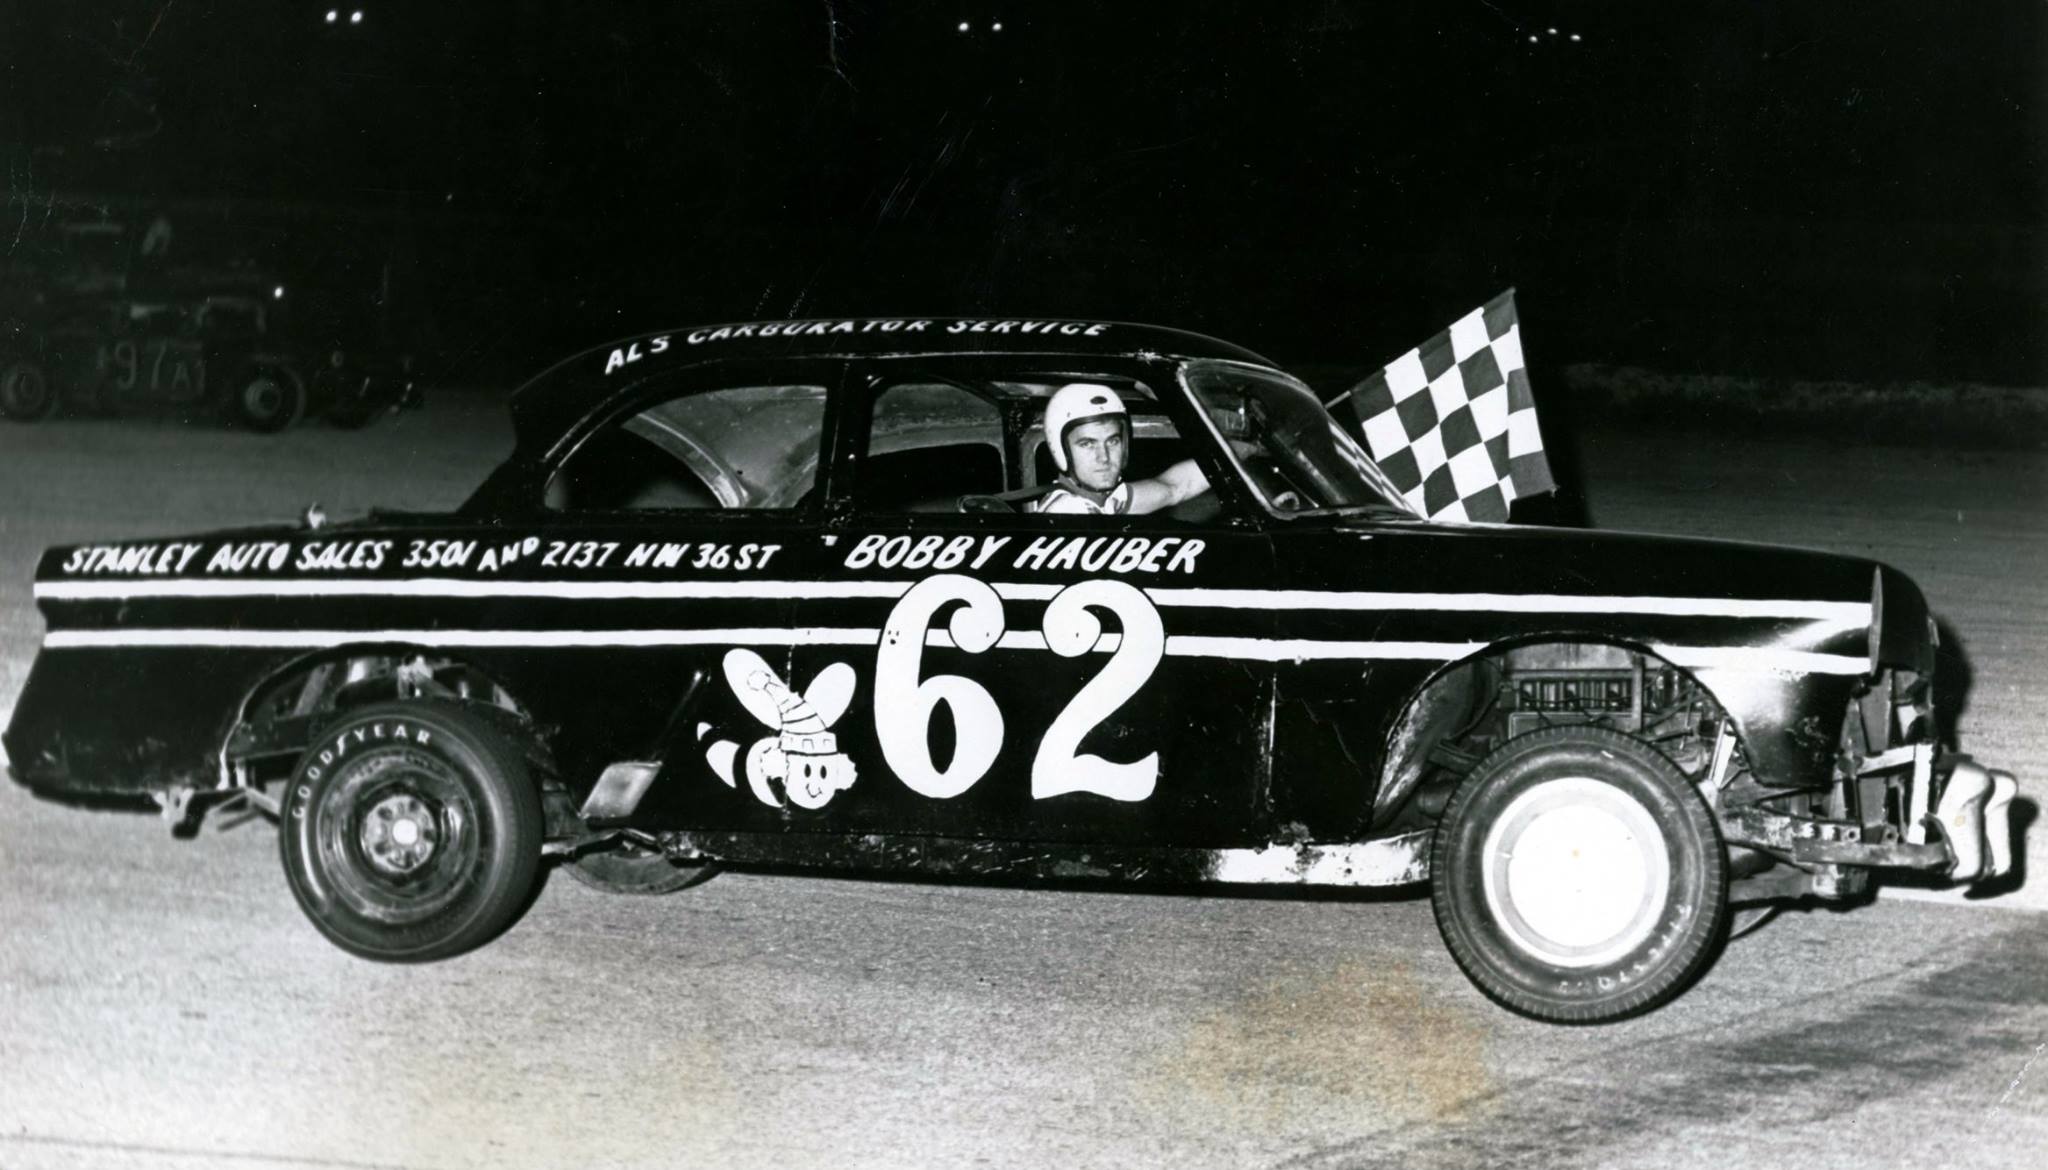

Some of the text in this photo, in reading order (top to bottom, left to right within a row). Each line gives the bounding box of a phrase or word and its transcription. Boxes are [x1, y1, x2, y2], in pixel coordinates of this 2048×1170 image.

[687, 319, 933, 344] CARBURATOR
[946, 319, 1111, 336] SERVICE
[62, 542, 202, 574] STANLEY
[205, 541, 291, 573] AUTO
[295, 540, 393, 571] SALES
[402, 539, 476, 568] 3501
[476, 535, 540, 573] AND
[541, 541, 620, 569] 2137
[624, 543, 691, 568] NW
[844, 534, 1207, 574] BOBBY HAUBER
[873, 573, 1165, 802] 62
[291, 723, 432, 820] GOODYEAR
